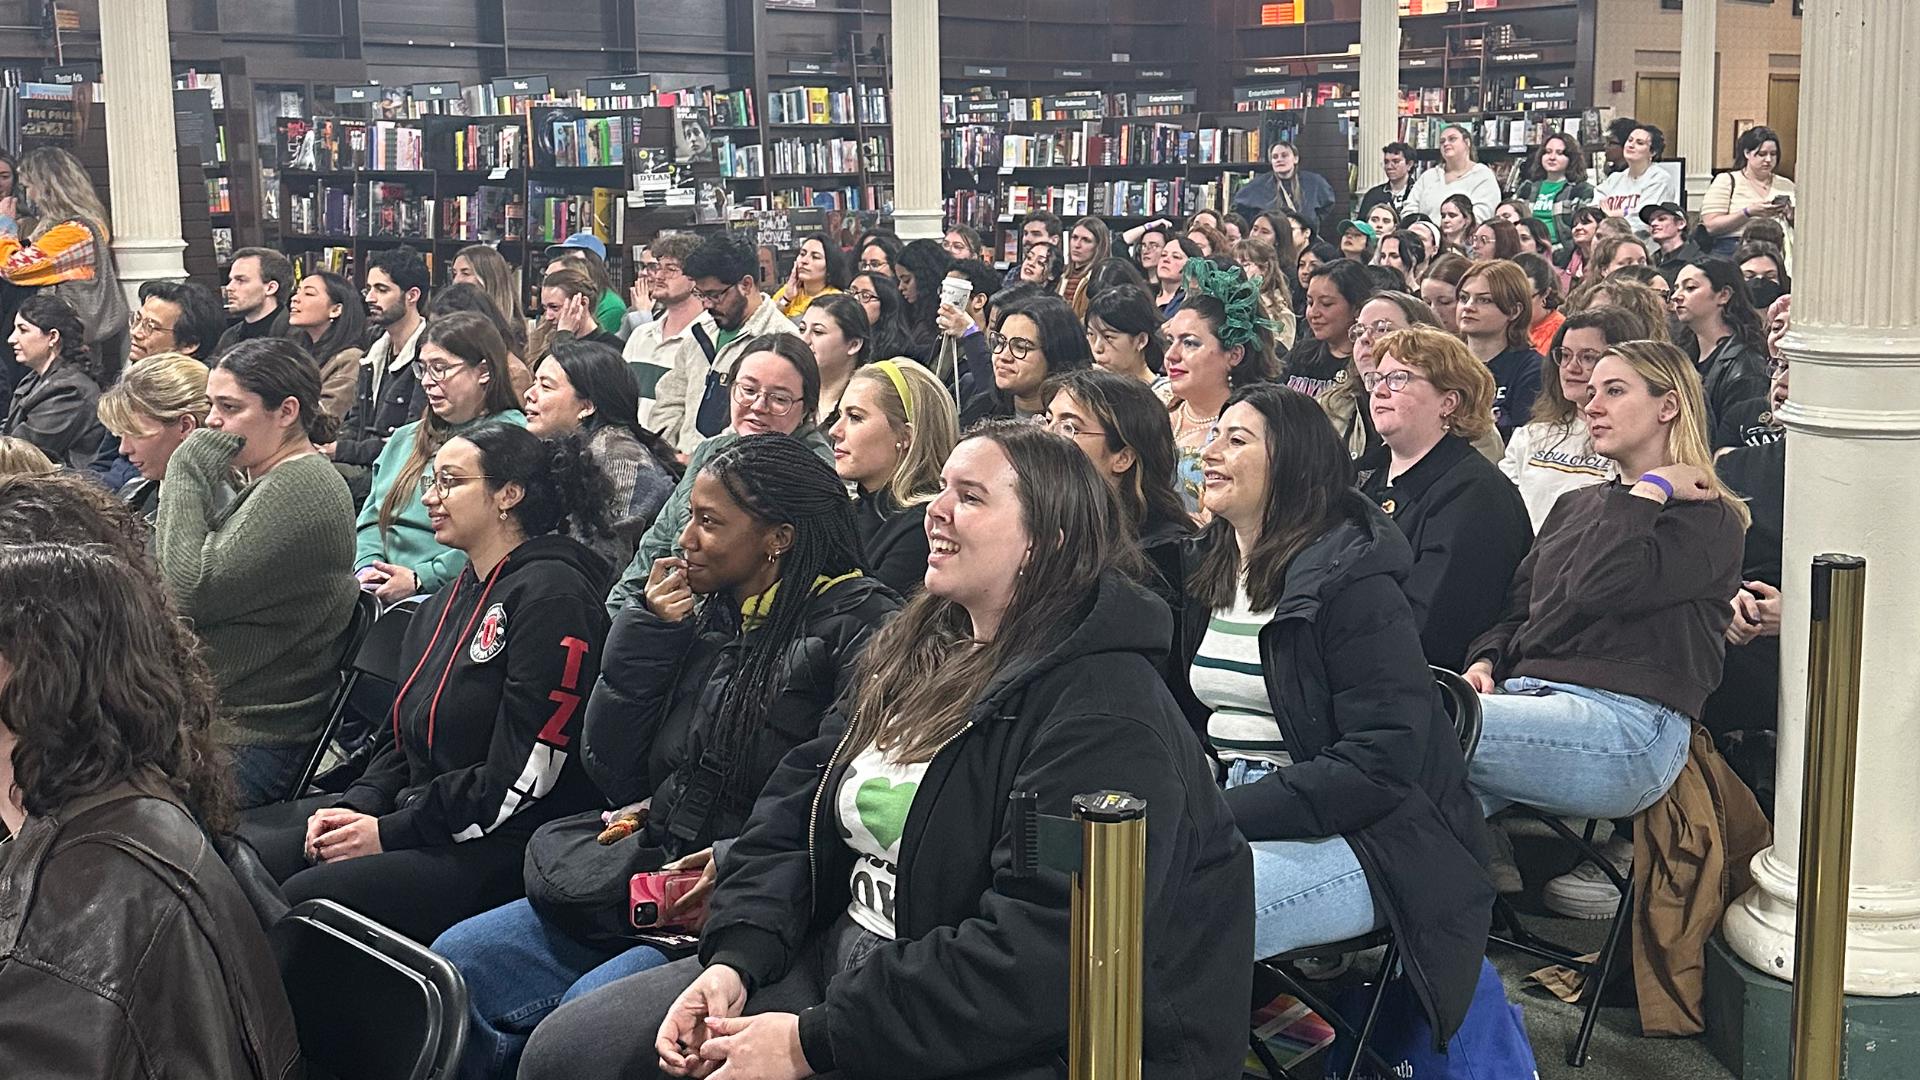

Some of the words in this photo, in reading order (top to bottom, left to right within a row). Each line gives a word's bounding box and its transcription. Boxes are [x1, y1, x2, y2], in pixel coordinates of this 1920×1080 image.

[1248, 88, 1286, 98] Entertainment
[1148, 95, 1183, 103] Entertainment
[1534, 449, 1612, 469] SOULCYCLE
